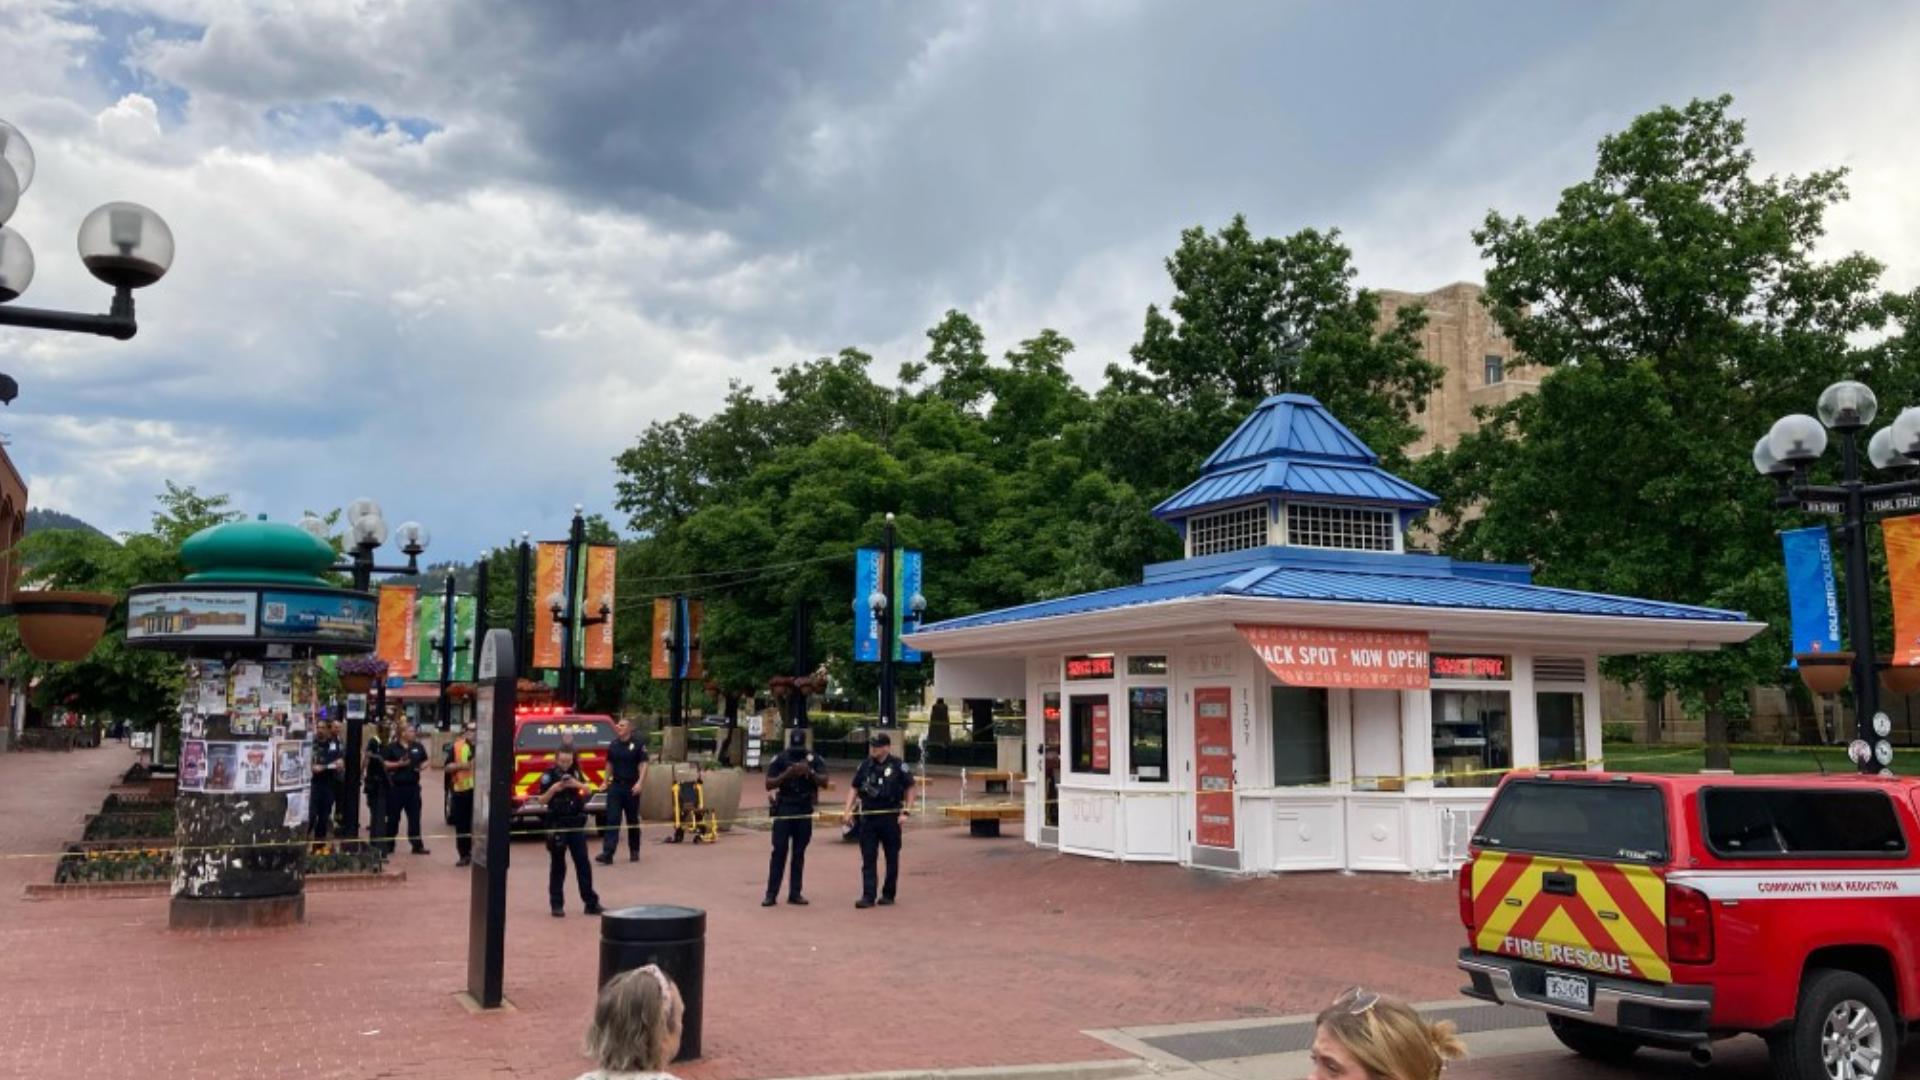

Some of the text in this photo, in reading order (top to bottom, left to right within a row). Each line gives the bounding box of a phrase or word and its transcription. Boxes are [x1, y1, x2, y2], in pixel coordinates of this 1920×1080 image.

[1299, 647, 1337, 666] SPOT
[1351, 649, 1382, 668] NOW
[1388, 650, 1428, 669] OPEN!
[1758, 882, 1817, 892] COMMUNITY
[1845, 881, 1898, 891] REDUCTION
[1504, 936, 1632, 974] FIRE RESCUE
